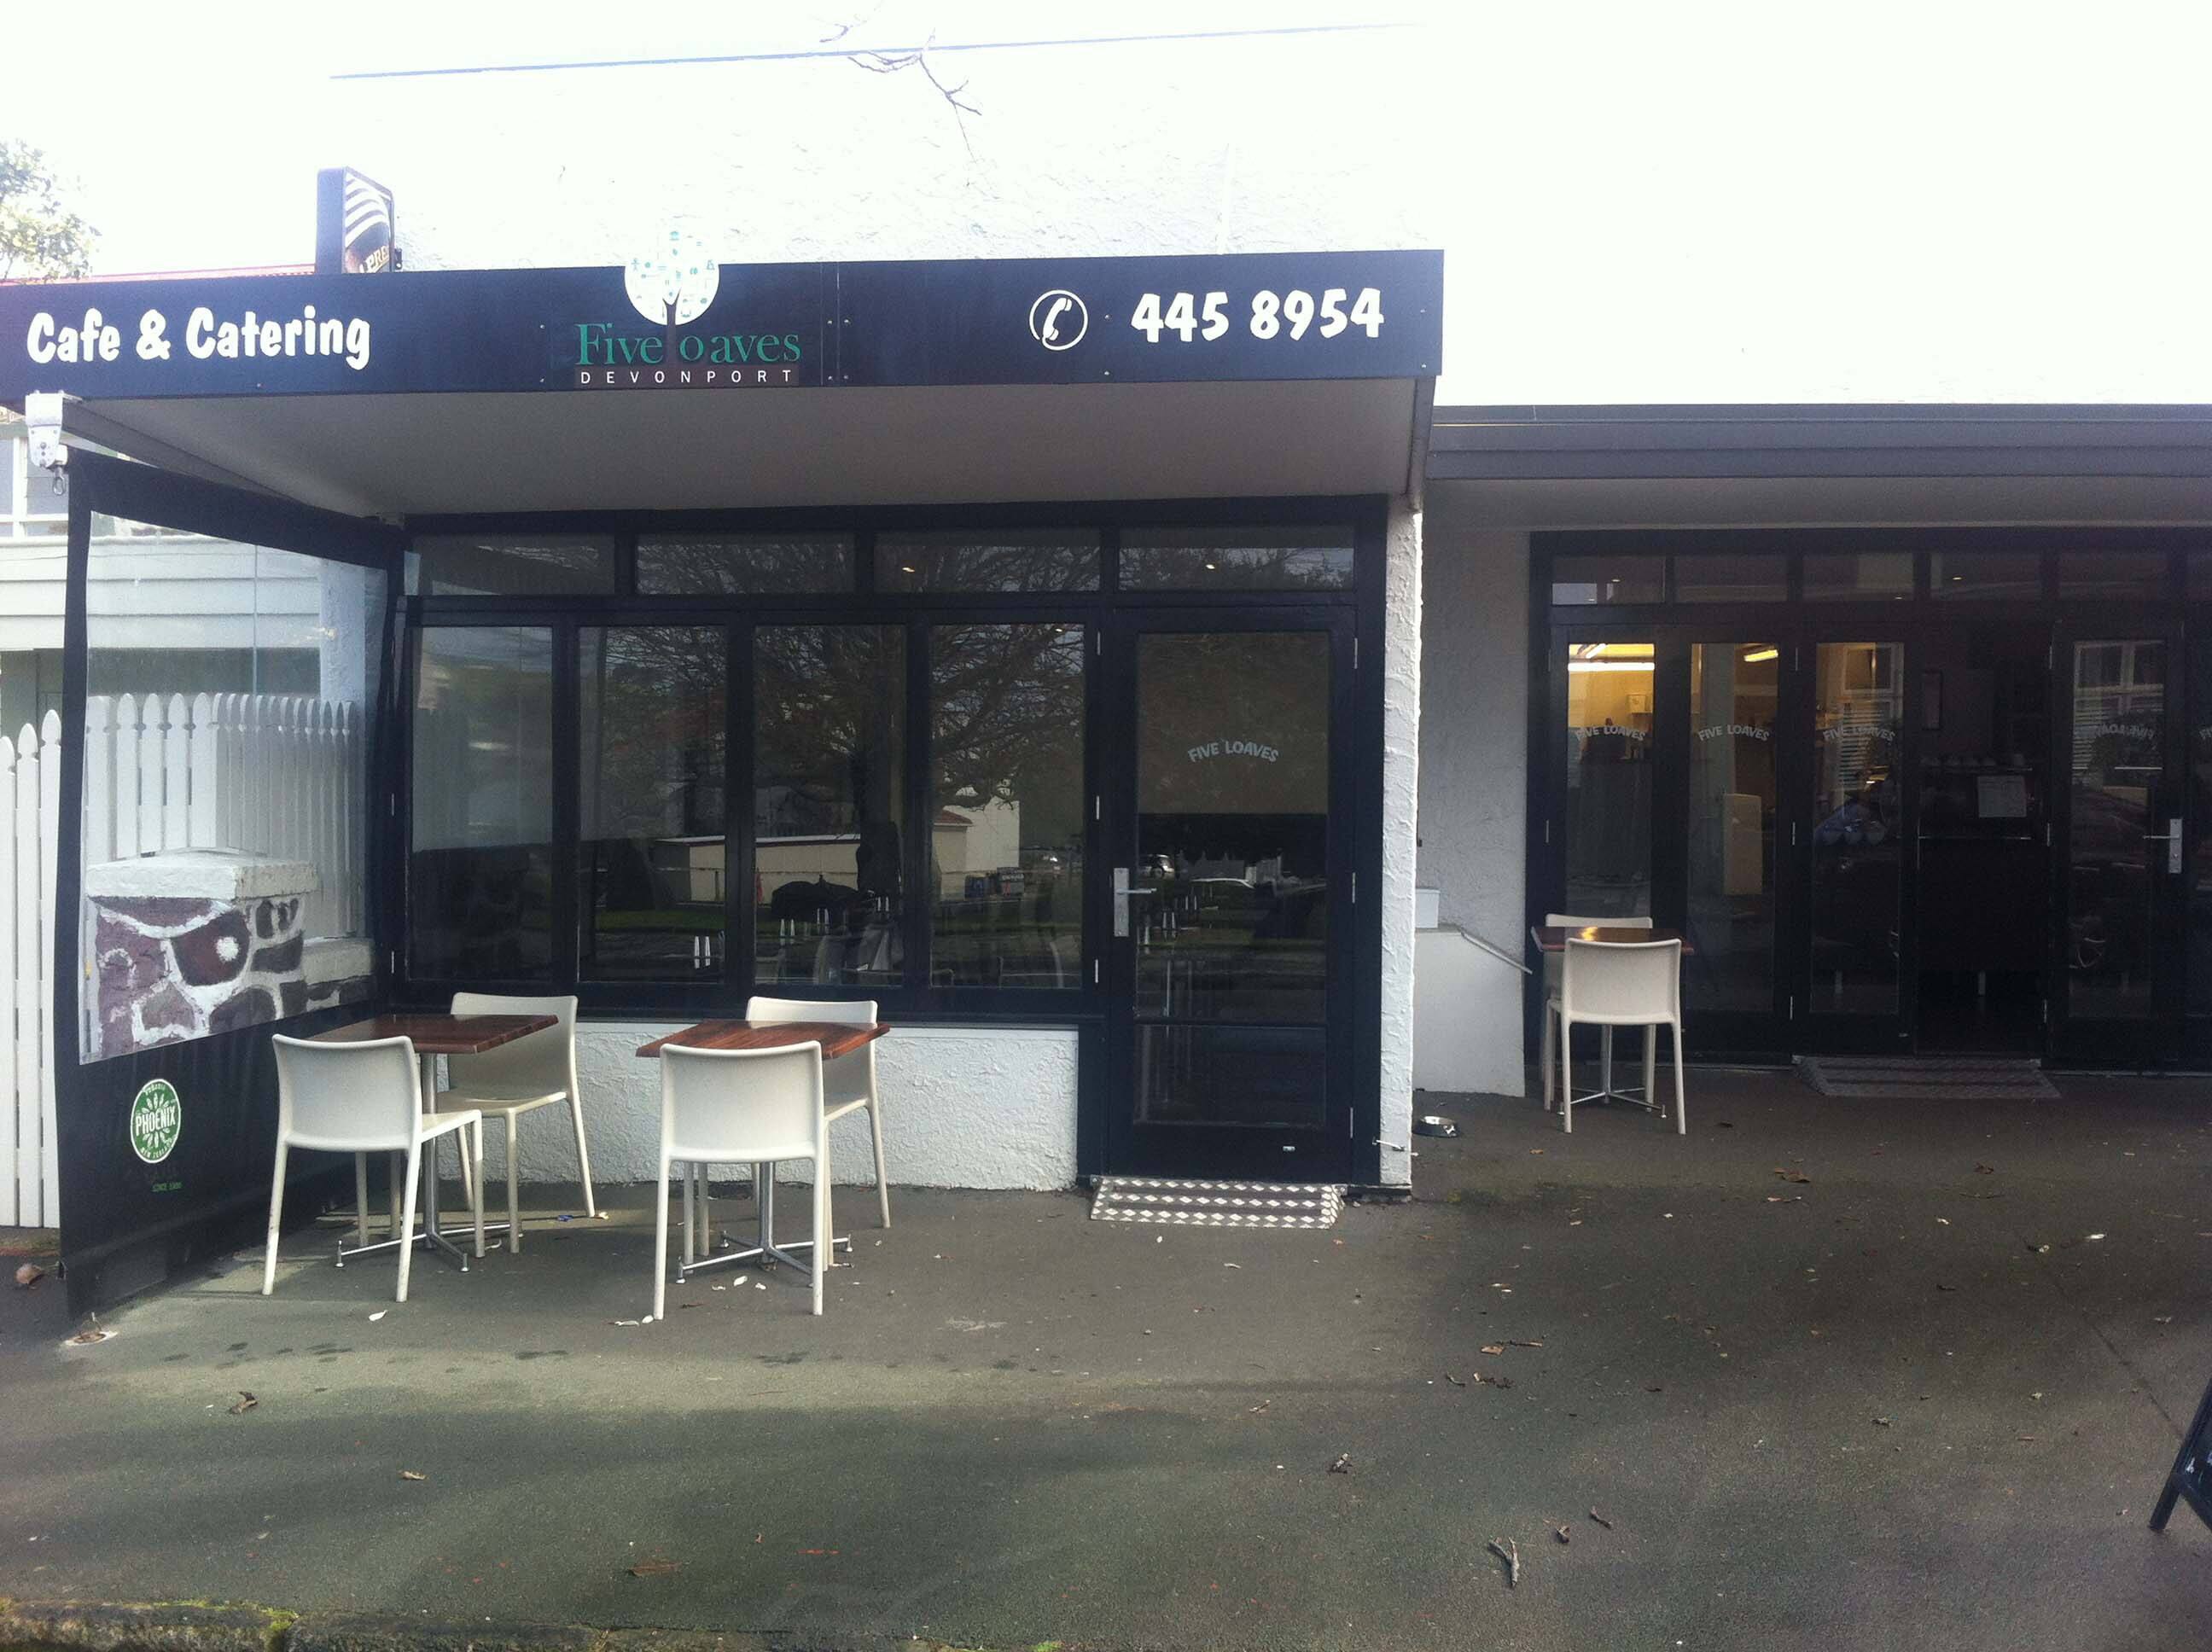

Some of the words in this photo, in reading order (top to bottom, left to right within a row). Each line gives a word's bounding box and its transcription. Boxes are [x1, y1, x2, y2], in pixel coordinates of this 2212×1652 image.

[1131, 291, 1230, 343] 445
[1249, 288, 1384, 341] 8954
[26, 308, 120, 364] Cafe
[136, 309, 171, 360] &
[185, 305, 370, 370] Catering
[574, 323, 664, 365] Five
[580, 369, 792, 384] DEVONPORT
[1575, 725, 1600, 742] FIVE
[1603, 724, 1646, 742] LOAVES
[1697, 725, 1723, 742] FIVE
[1726, 724, 1770, 742] LOAVES
[1187, 742, 1220, 763] FIVE
[1225, 741, 1279, 763] LOAVES
[135, 1105, 176, 1137] PHOENIX
